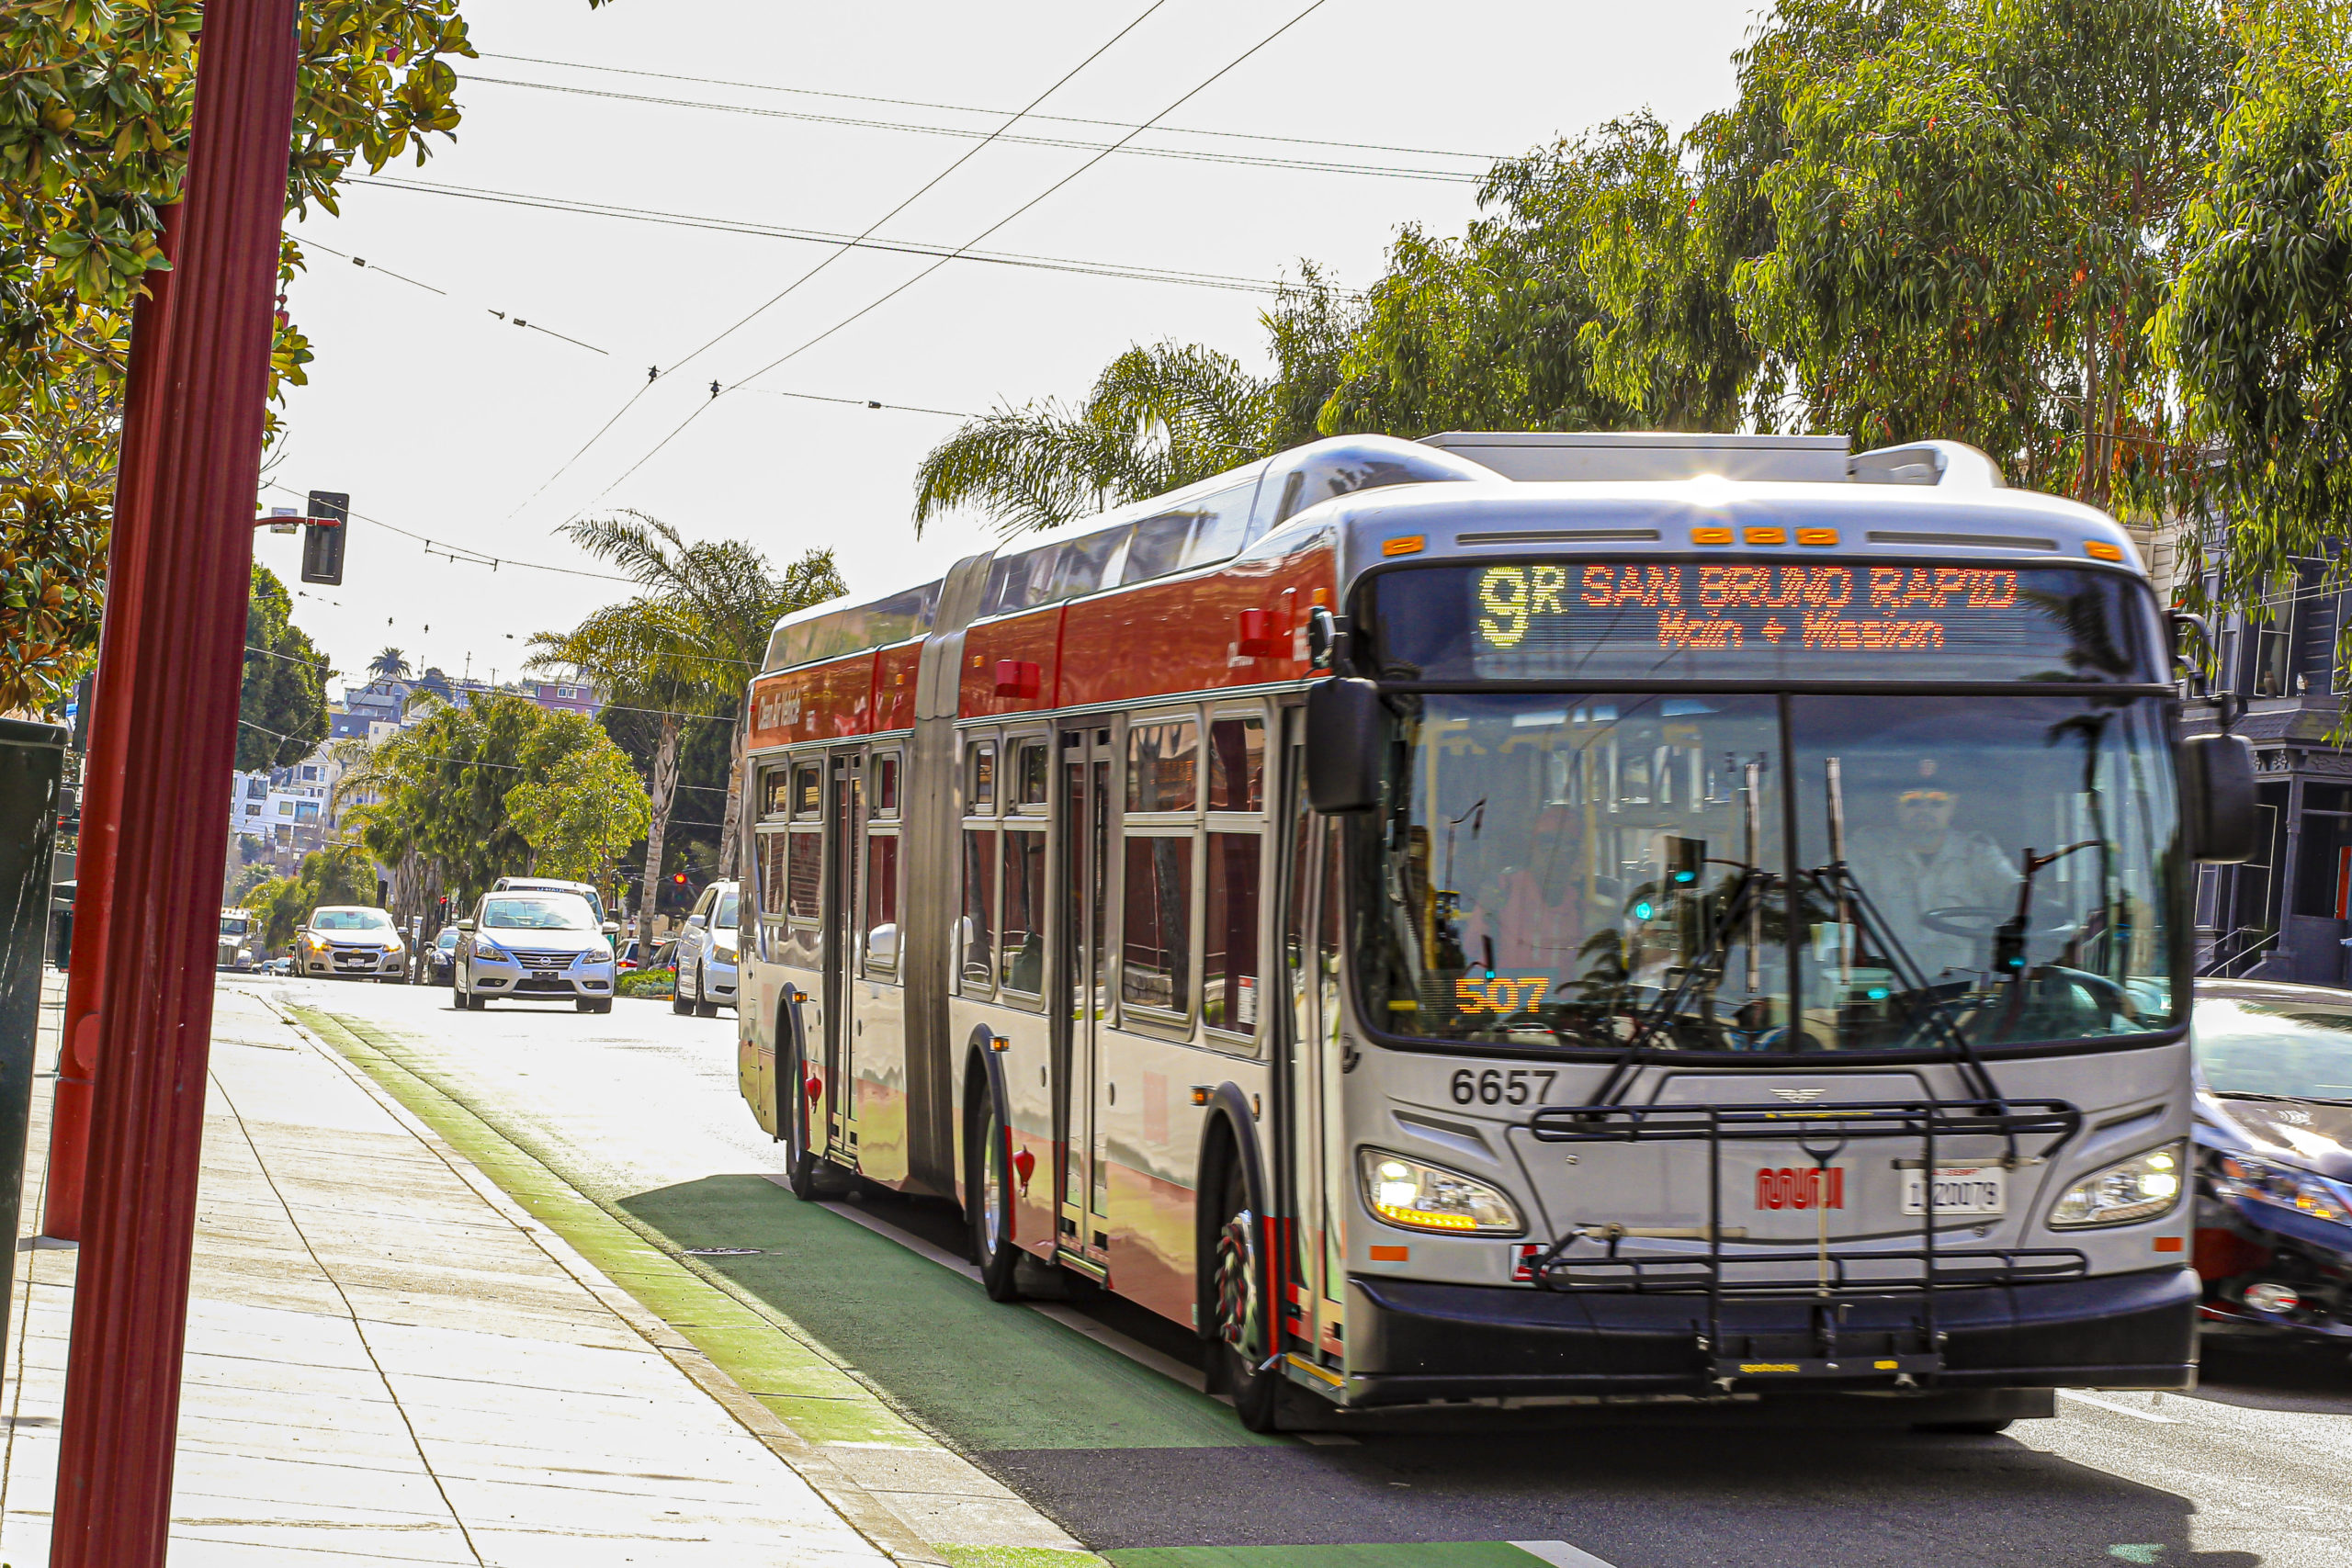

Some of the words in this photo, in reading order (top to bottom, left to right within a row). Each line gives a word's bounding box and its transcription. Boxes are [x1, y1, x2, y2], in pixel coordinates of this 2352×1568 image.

[1580, 565, 1681, 607] SAN
[1699, 566, 1852, 608] BRUNO
[1870, 567, 2018, 608] RAPID
[1657, 609, 1744, 648] Main
[1802, 610, 1945, 649] Mission
[1455, 977, 1550, 1013] 507
[1452, 1068, 1558, 1105] 6657
